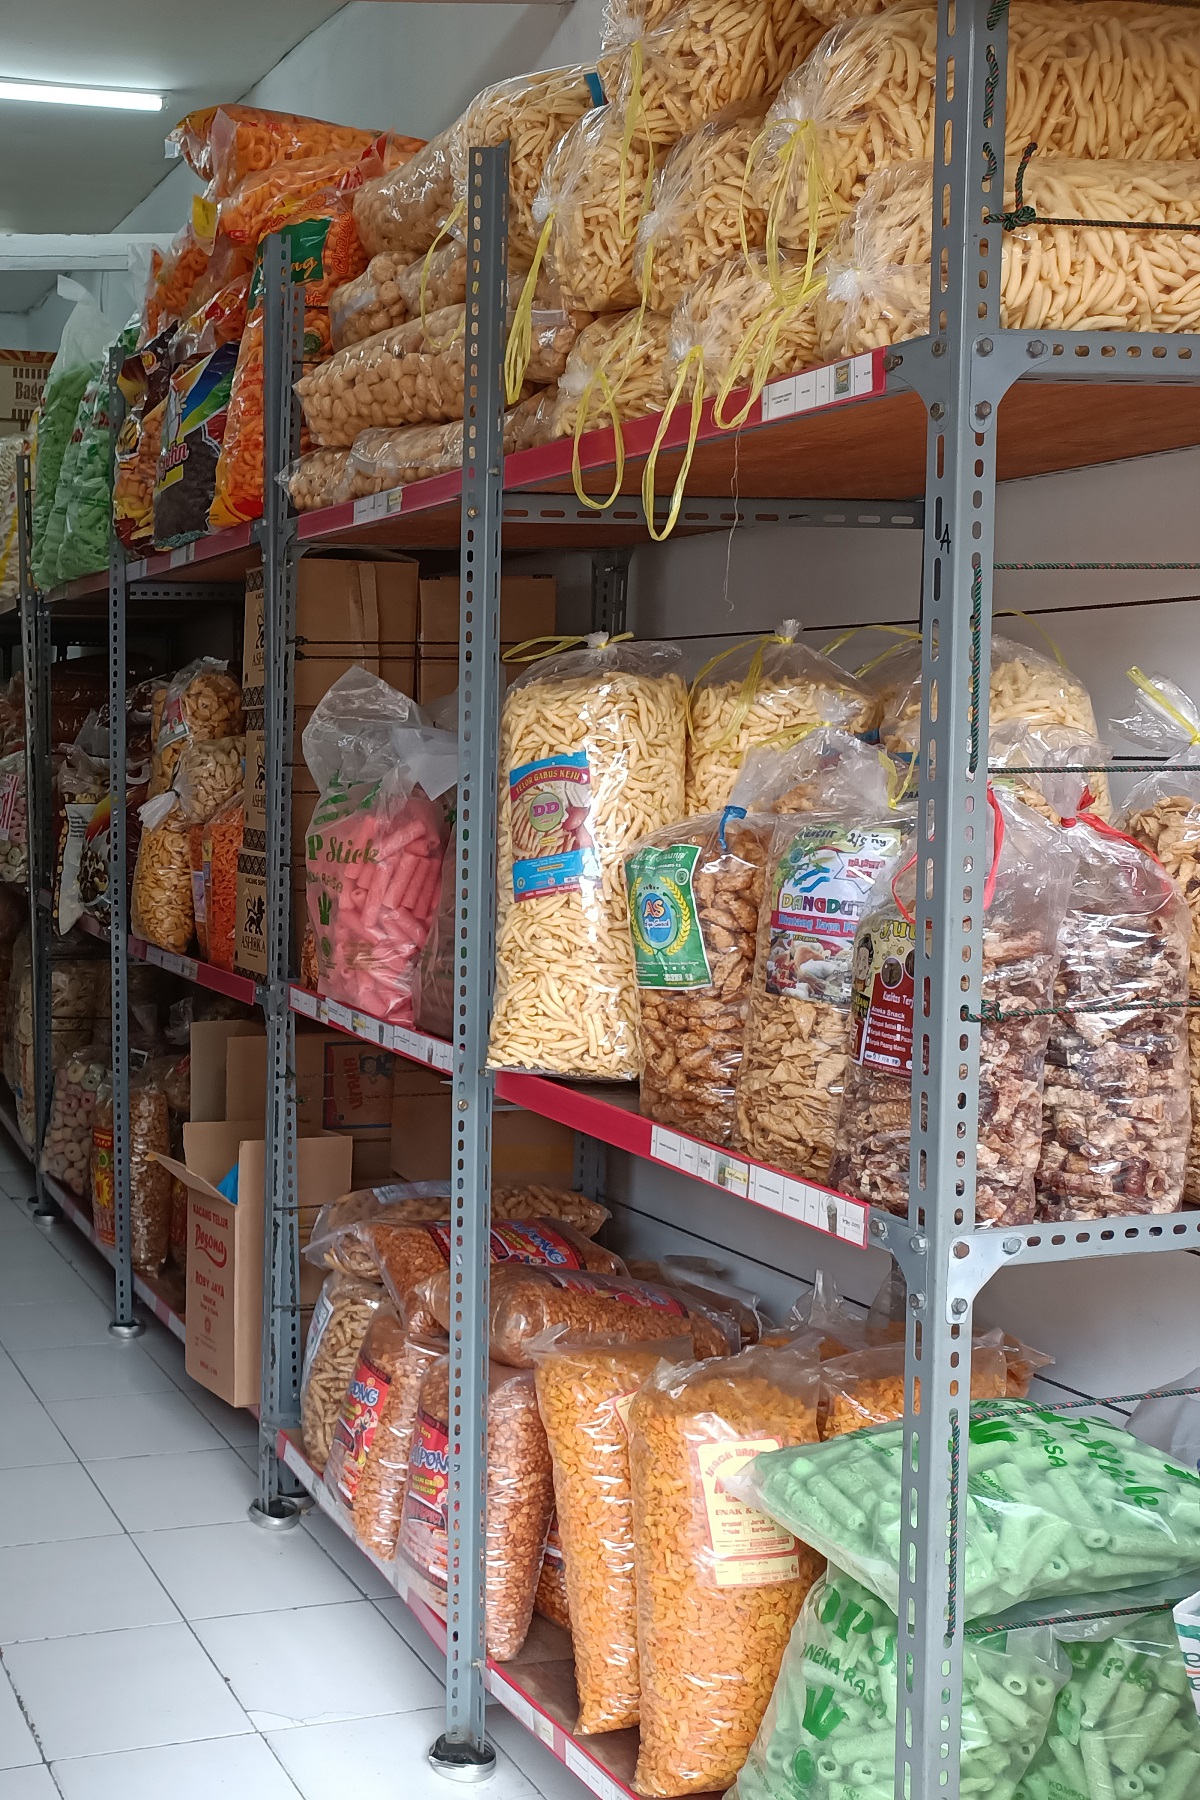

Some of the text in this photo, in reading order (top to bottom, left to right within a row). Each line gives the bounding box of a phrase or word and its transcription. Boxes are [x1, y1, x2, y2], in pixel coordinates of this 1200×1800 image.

[331, 212, 350, 274] Cheese
[533, 771, 558, 783] GABUS
[532, 801, 560, 818] DD
[326, 834, 380, 865] Stick
[643, 898, 666, 918] AS
[782, 894, 865, 917] DANGDUT
[241, 935, 266, 954] ASHOKA
[887, 1009, 905, 1019] Snack
[715, 1508, 742, 1516] ENAK
